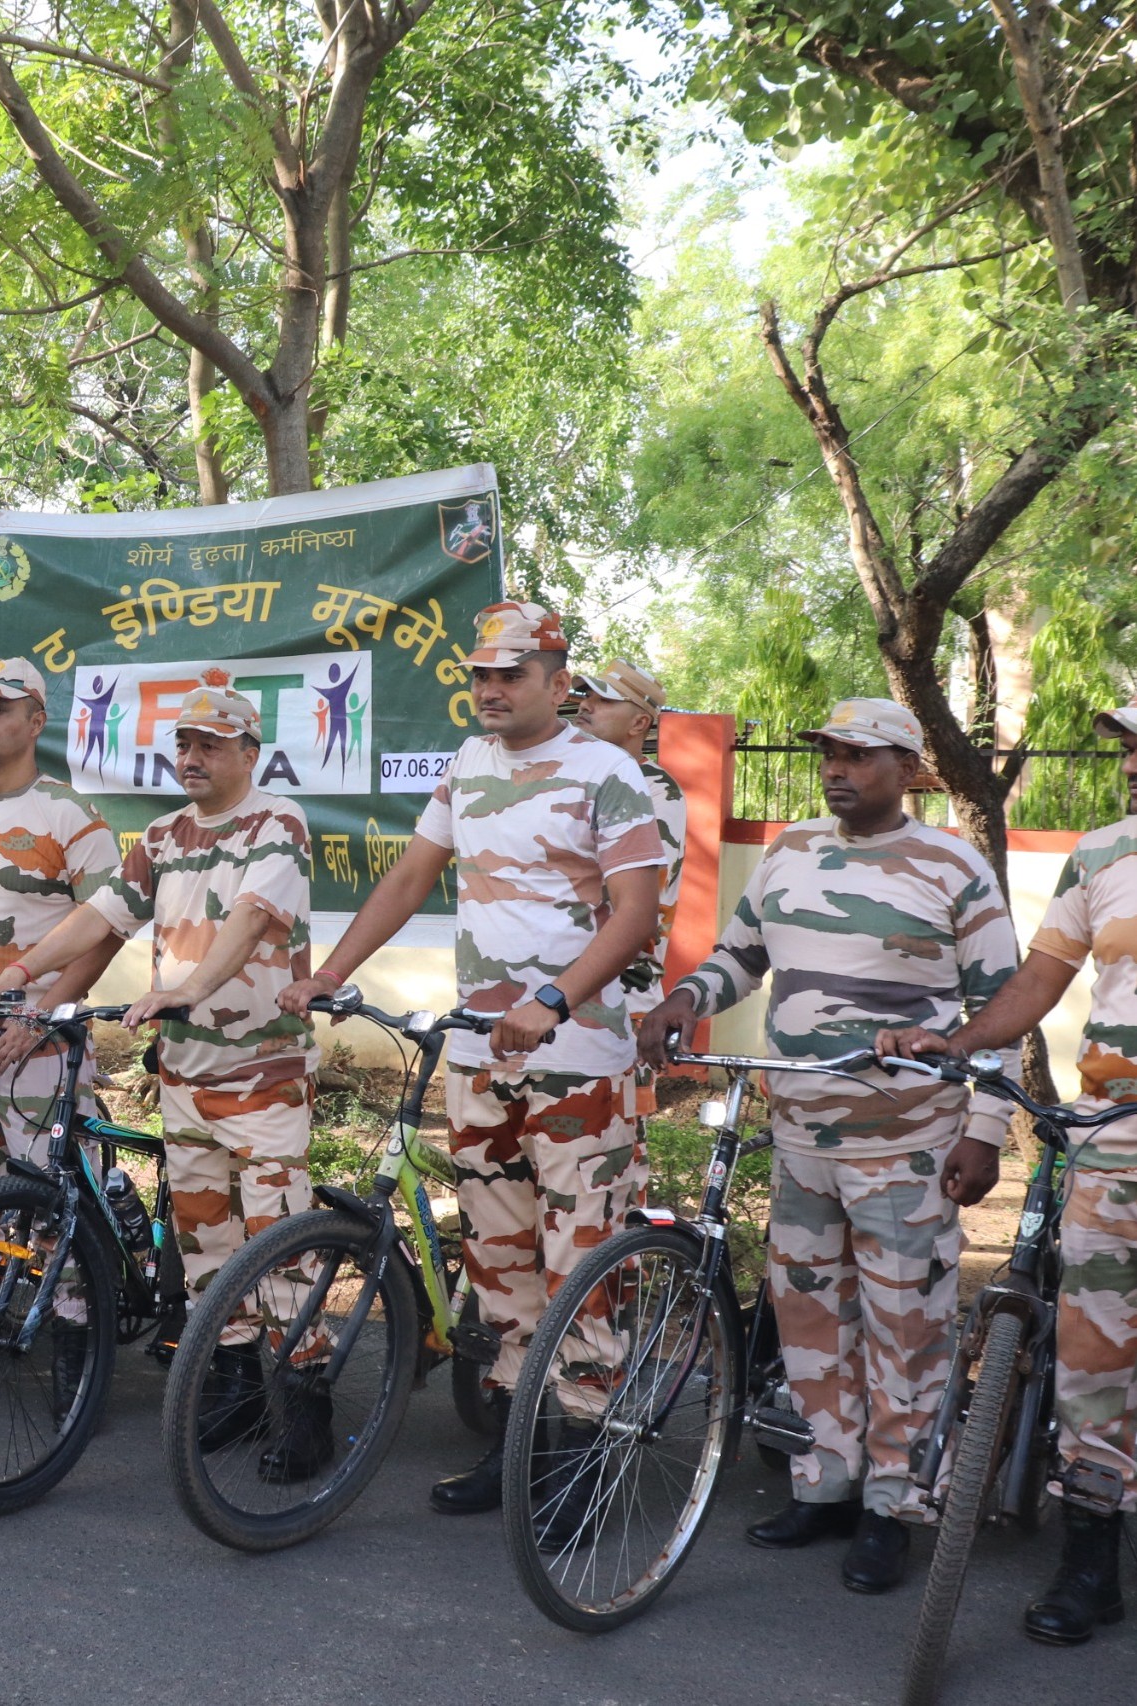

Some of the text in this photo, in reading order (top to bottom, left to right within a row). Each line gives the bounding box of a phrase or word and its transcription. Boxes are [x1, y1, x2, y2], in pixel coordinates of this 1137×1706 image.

[127, 528, 357, 571] शौर्य दृढ़ता कर्मनिष्ठा
[135, 674, 304, 746] FT
[133, 750, 301, 787] INA
